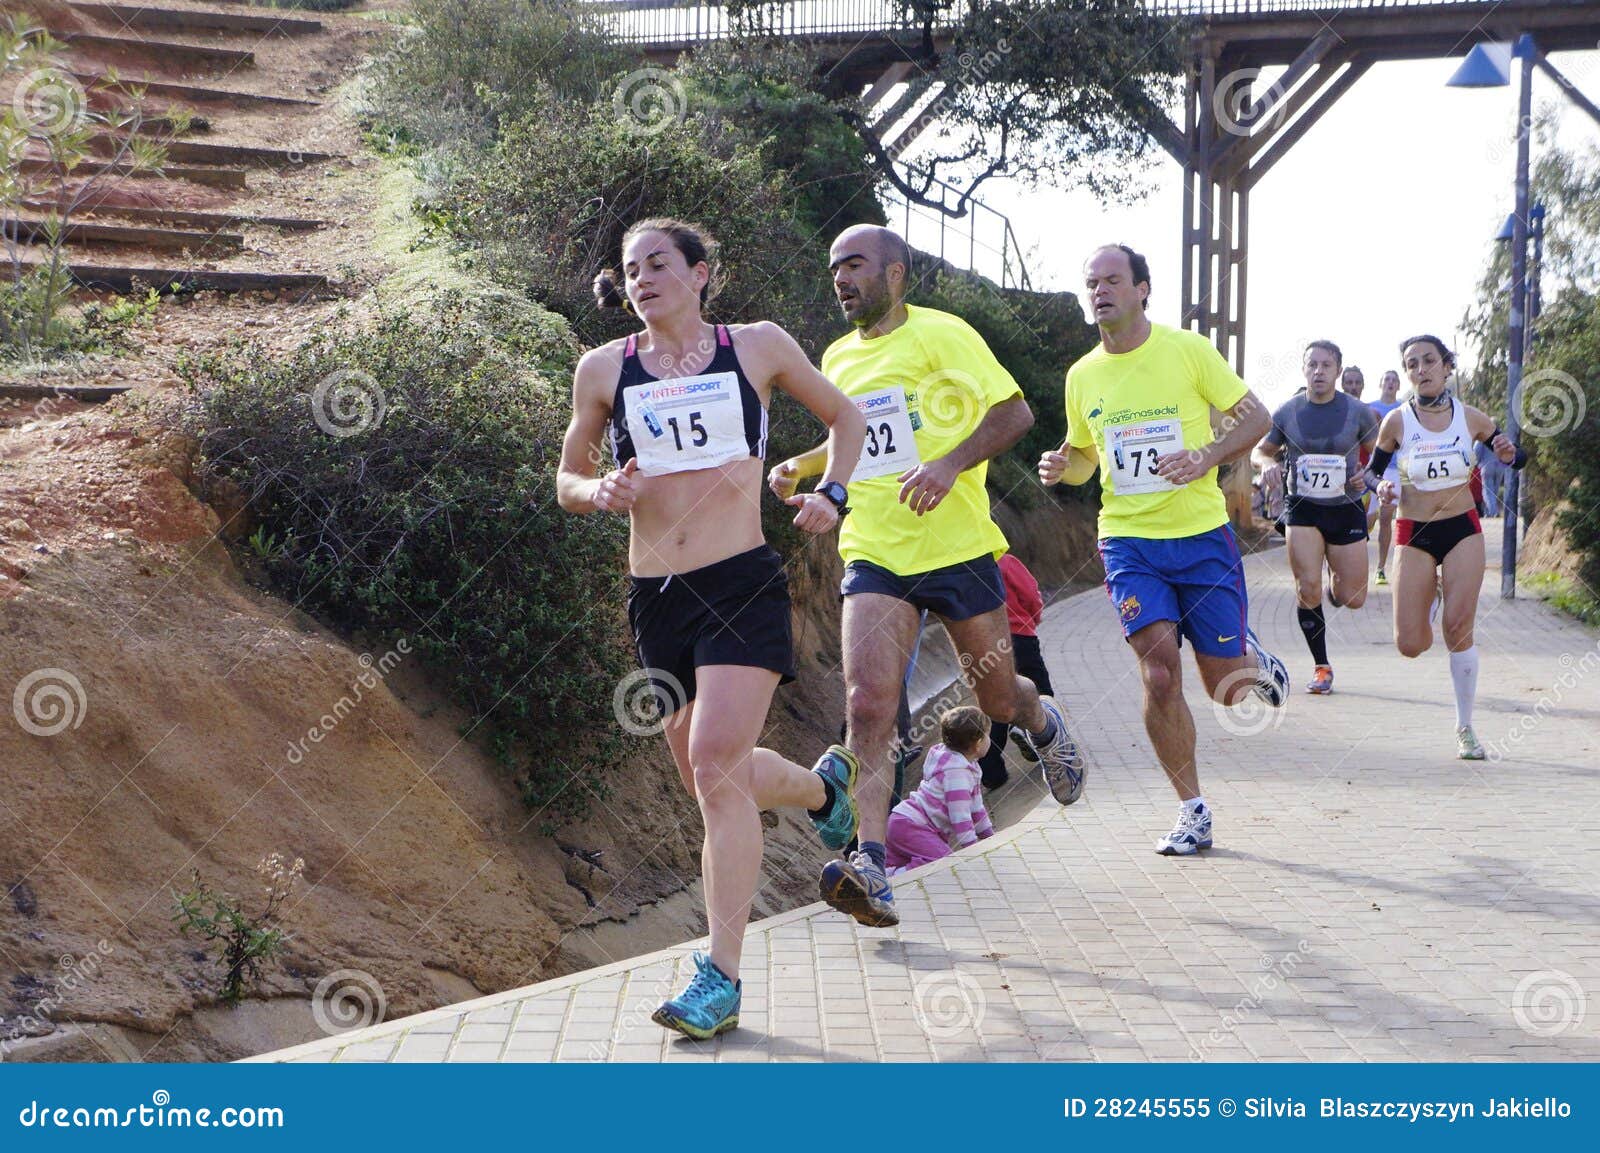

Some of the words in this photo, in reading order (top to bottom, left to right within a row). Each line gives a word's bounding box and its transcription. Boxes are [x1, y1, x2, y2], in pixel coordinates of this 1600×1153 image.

[652, 381, 721, 399] INTERSPORT
[667, 411, 708, 451] 15
[866, 422, 896, 457] 32
[1122, 425, 1170, 438] INTERSPORT
[1130, 447, 1159, 477] 73
[1427, 460, 1449, 479] 65
[1311, 472, 1330, 488] 72
